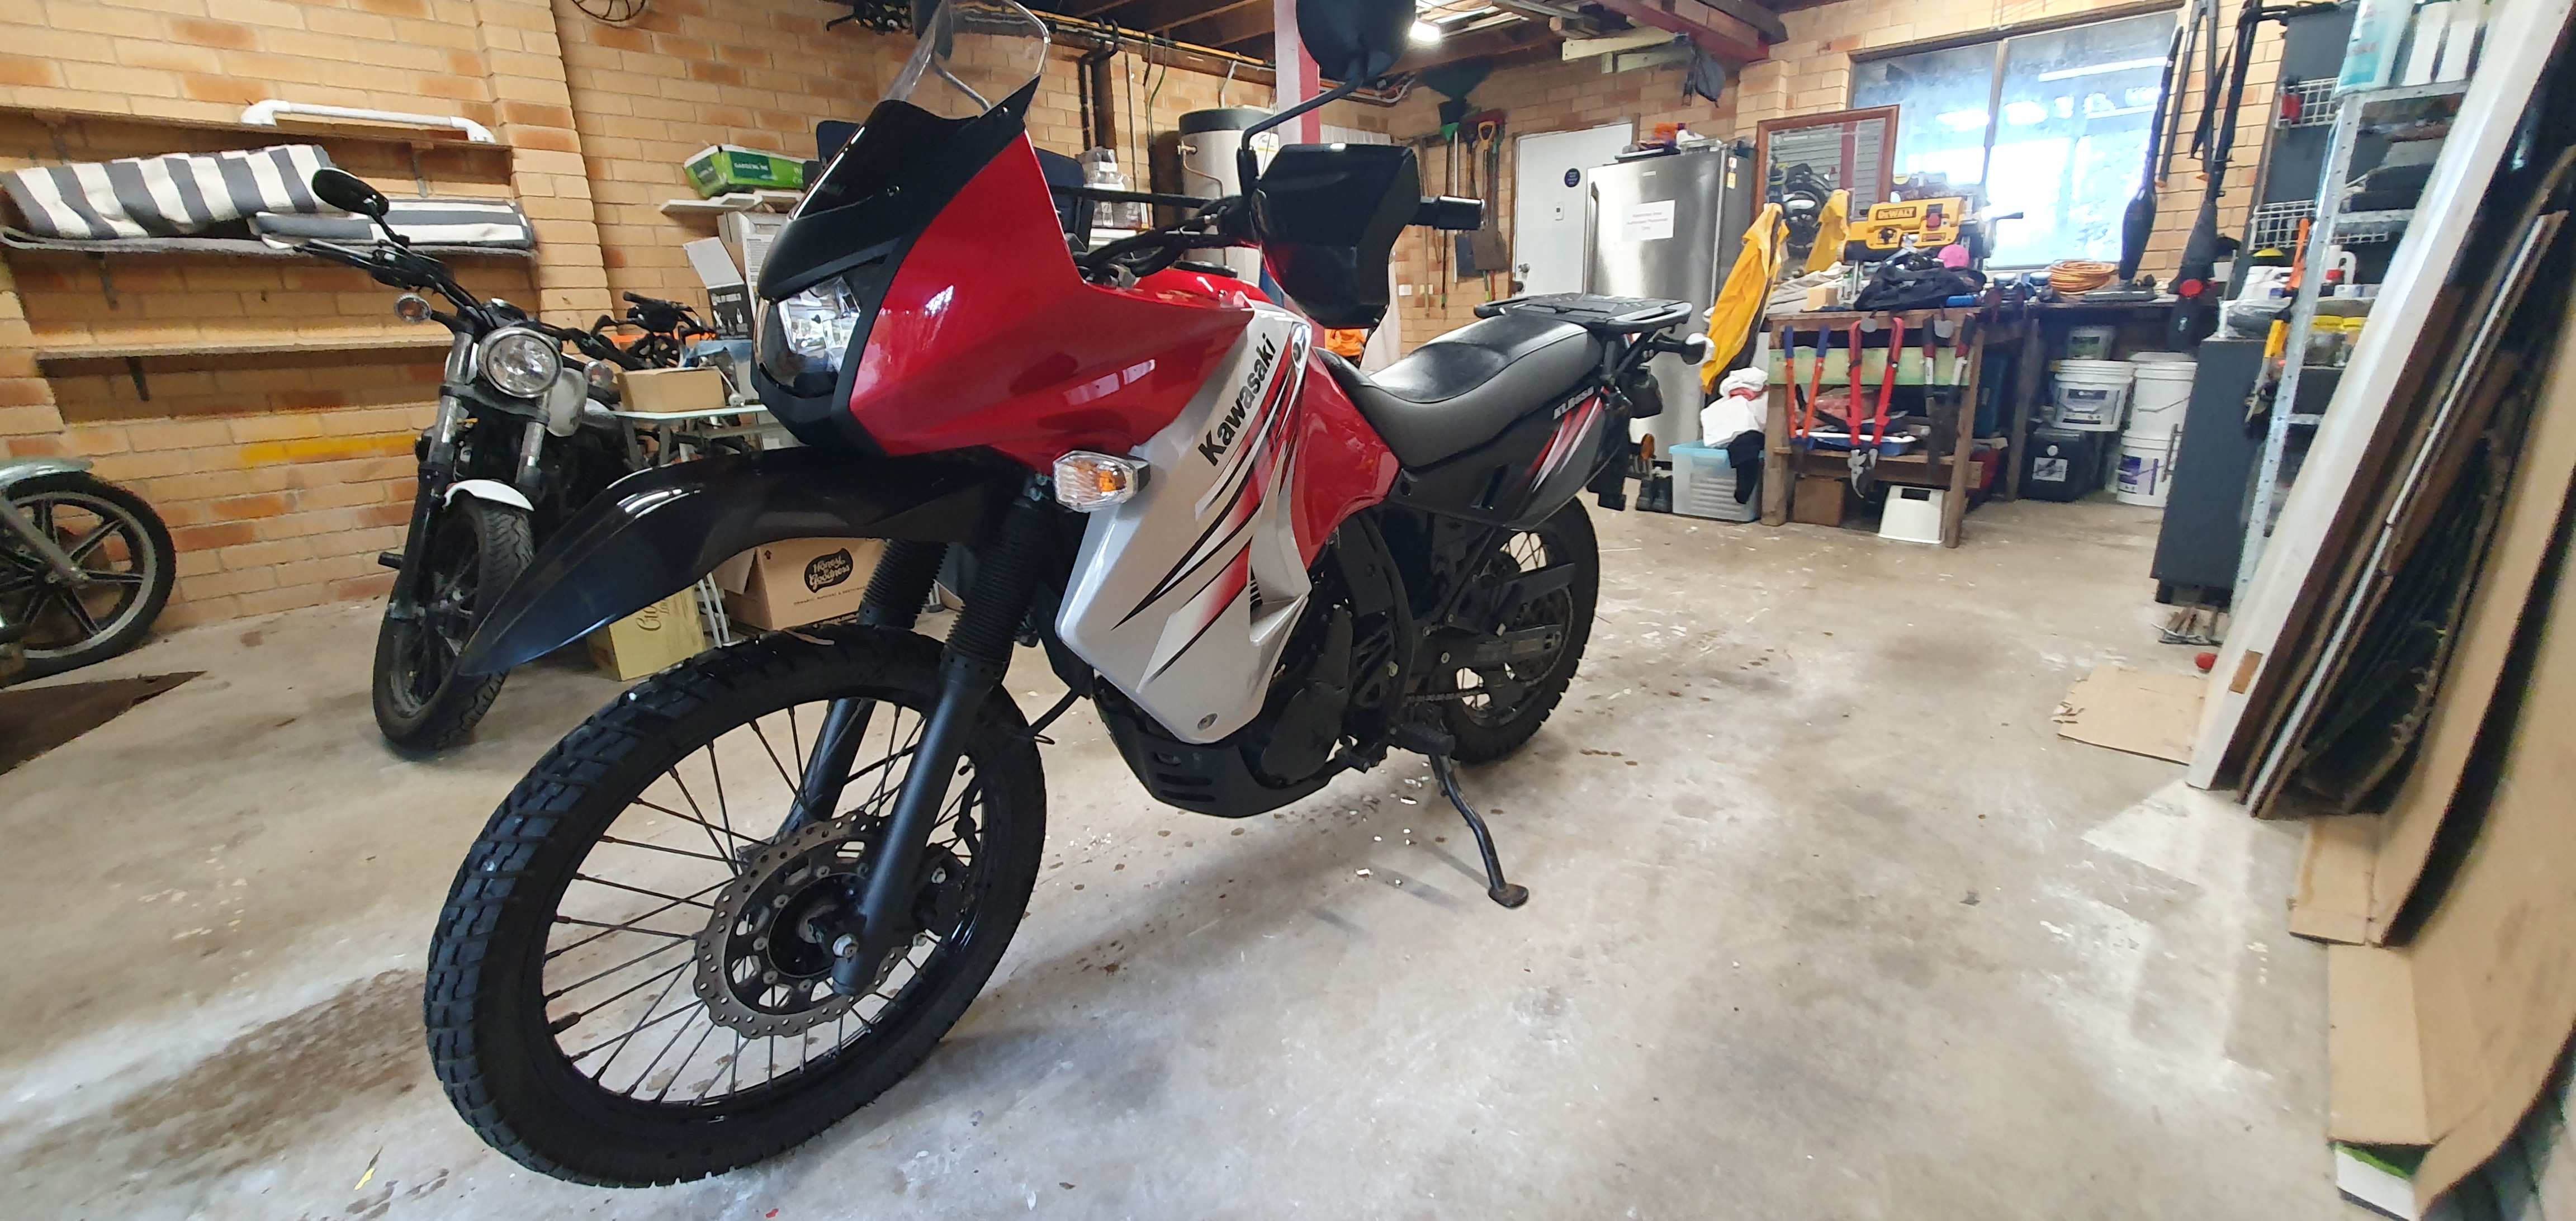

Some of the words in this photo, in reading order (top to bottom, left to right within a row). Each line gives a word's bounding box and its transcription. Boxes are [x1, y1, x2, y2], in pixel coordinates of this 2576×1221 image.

[1198, 332, 1276, 467] Kawasaki
[813, 555, 845, 573] Honest
[809, 565, 850, 590] Goodness
